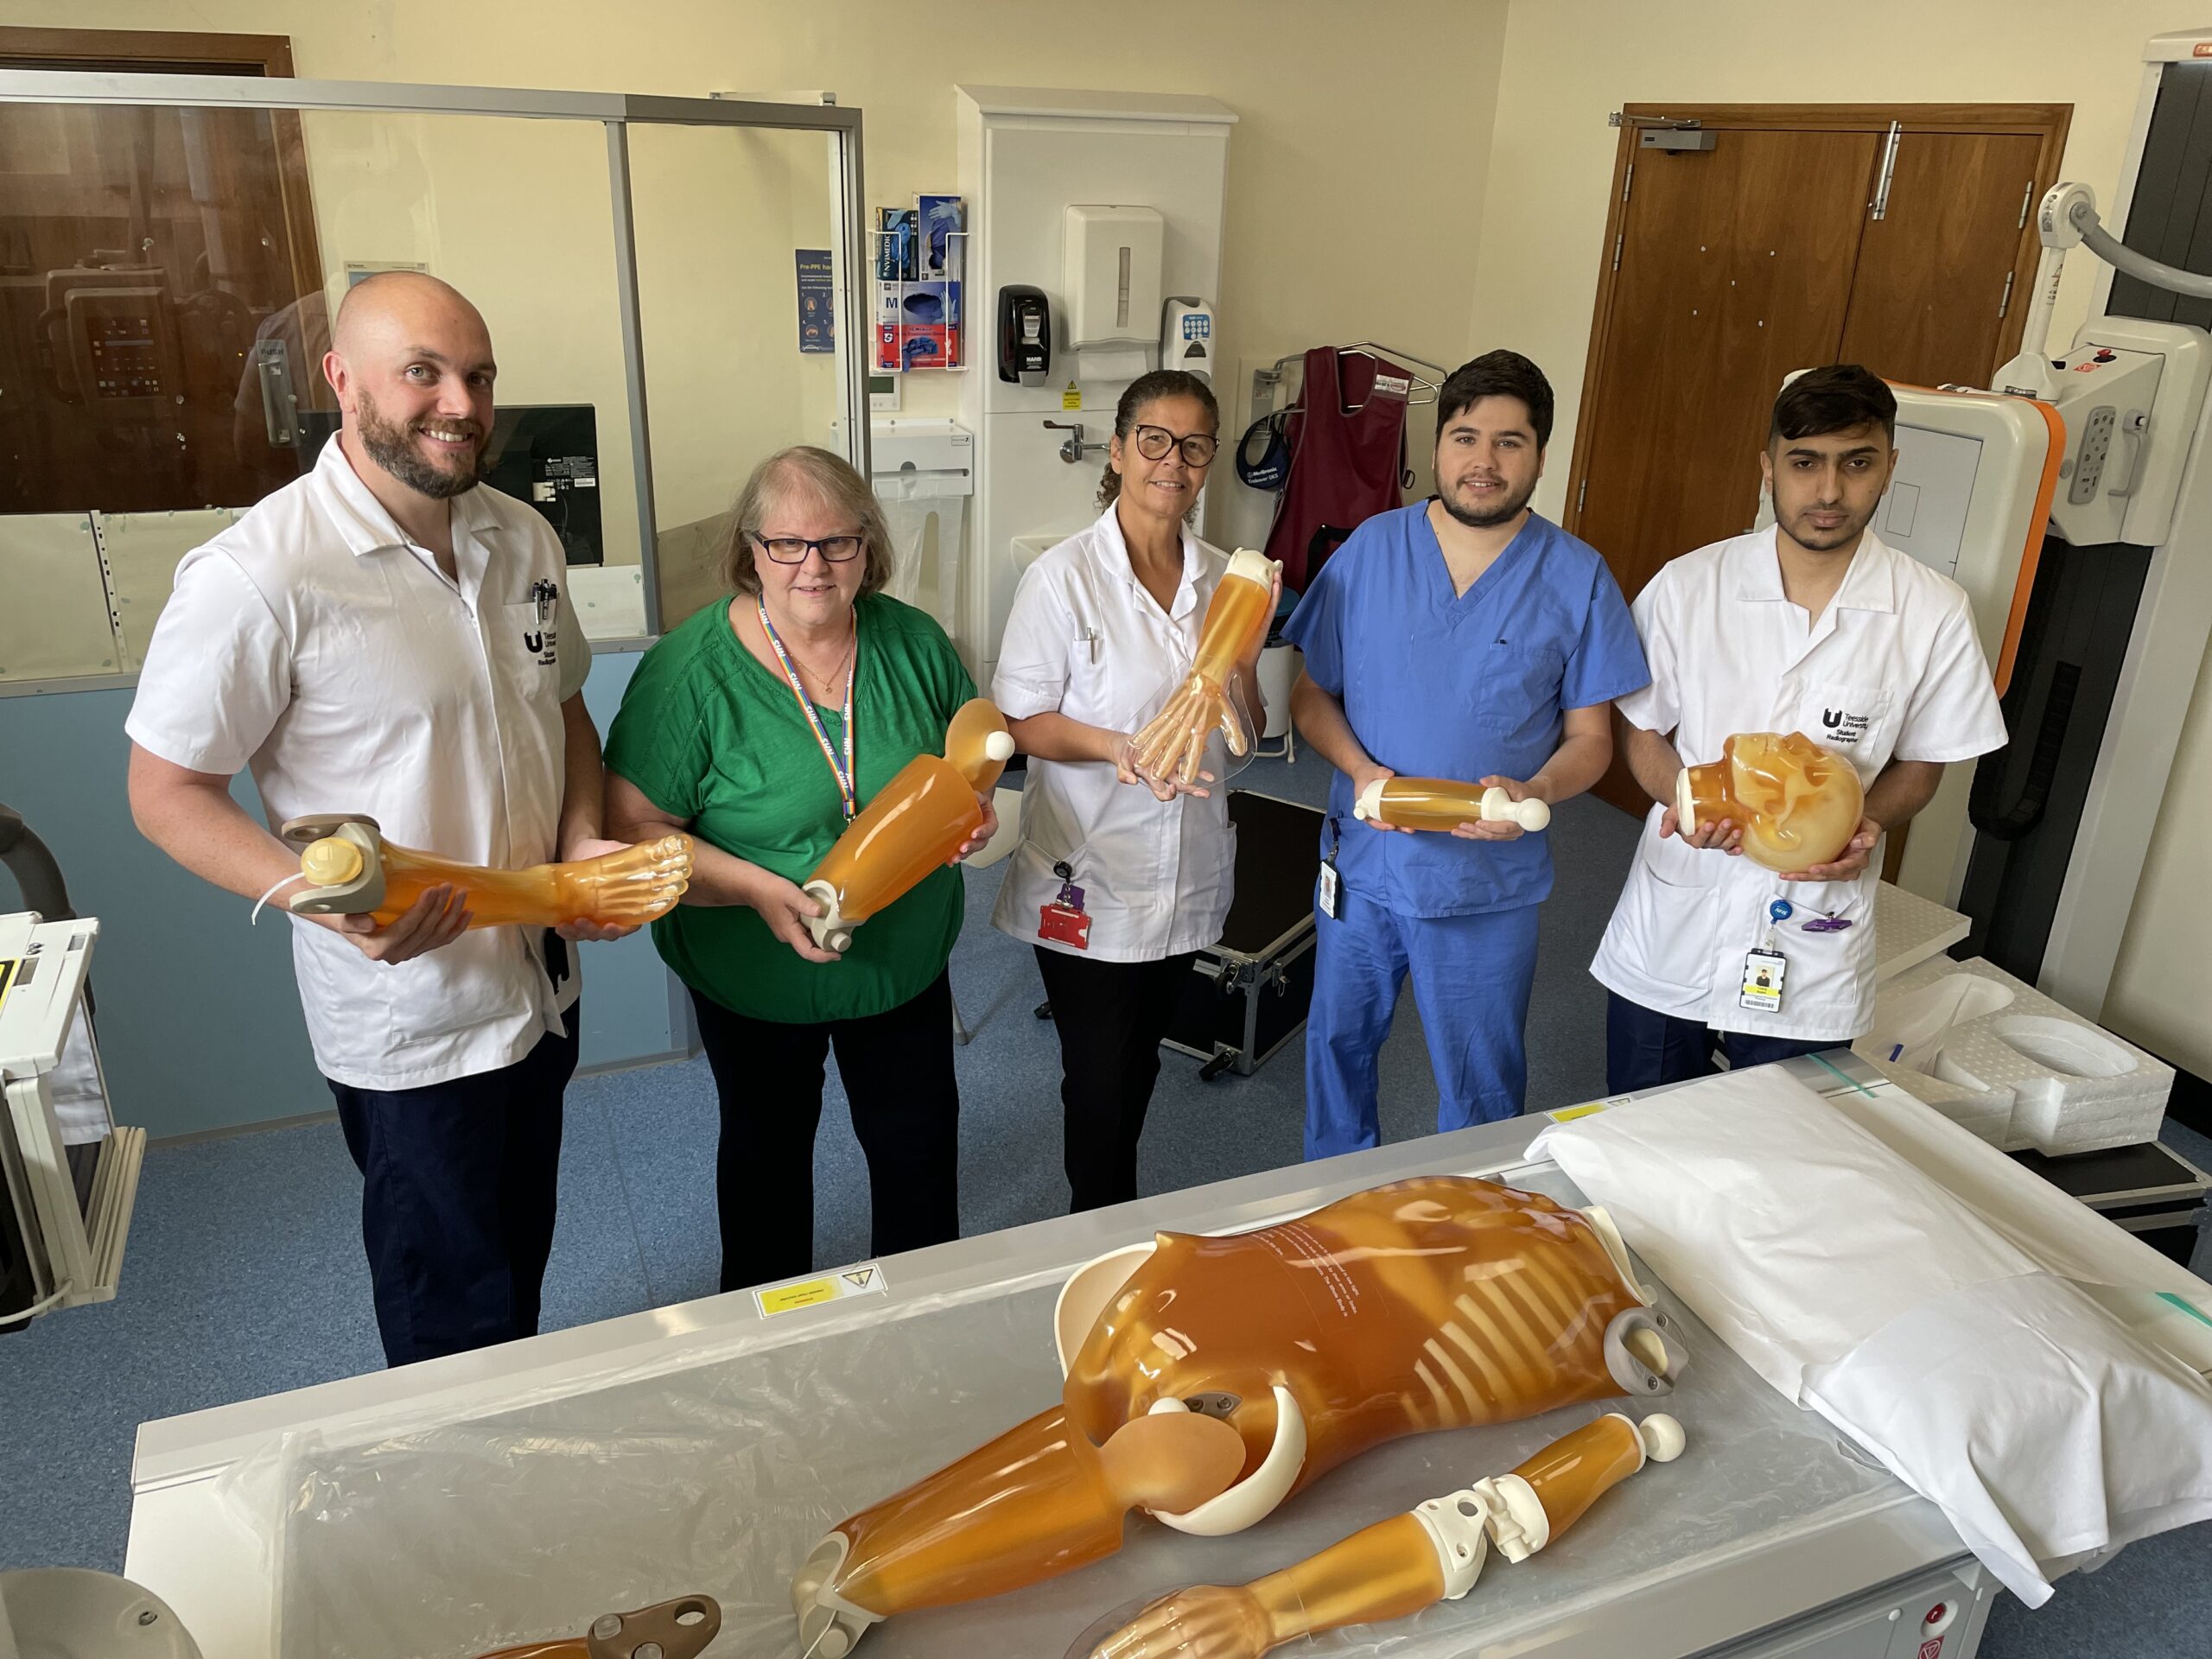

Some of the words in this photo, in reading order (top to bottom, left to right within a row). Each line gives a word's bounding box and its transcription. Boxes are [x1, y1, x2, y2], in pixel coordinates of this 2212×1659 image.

[886, 297, 898, 308] M
[805, 705, 818, 723] NHS
[823, 737, 835, 756] NHS
[1774, 907, 1788, 916] NHS
